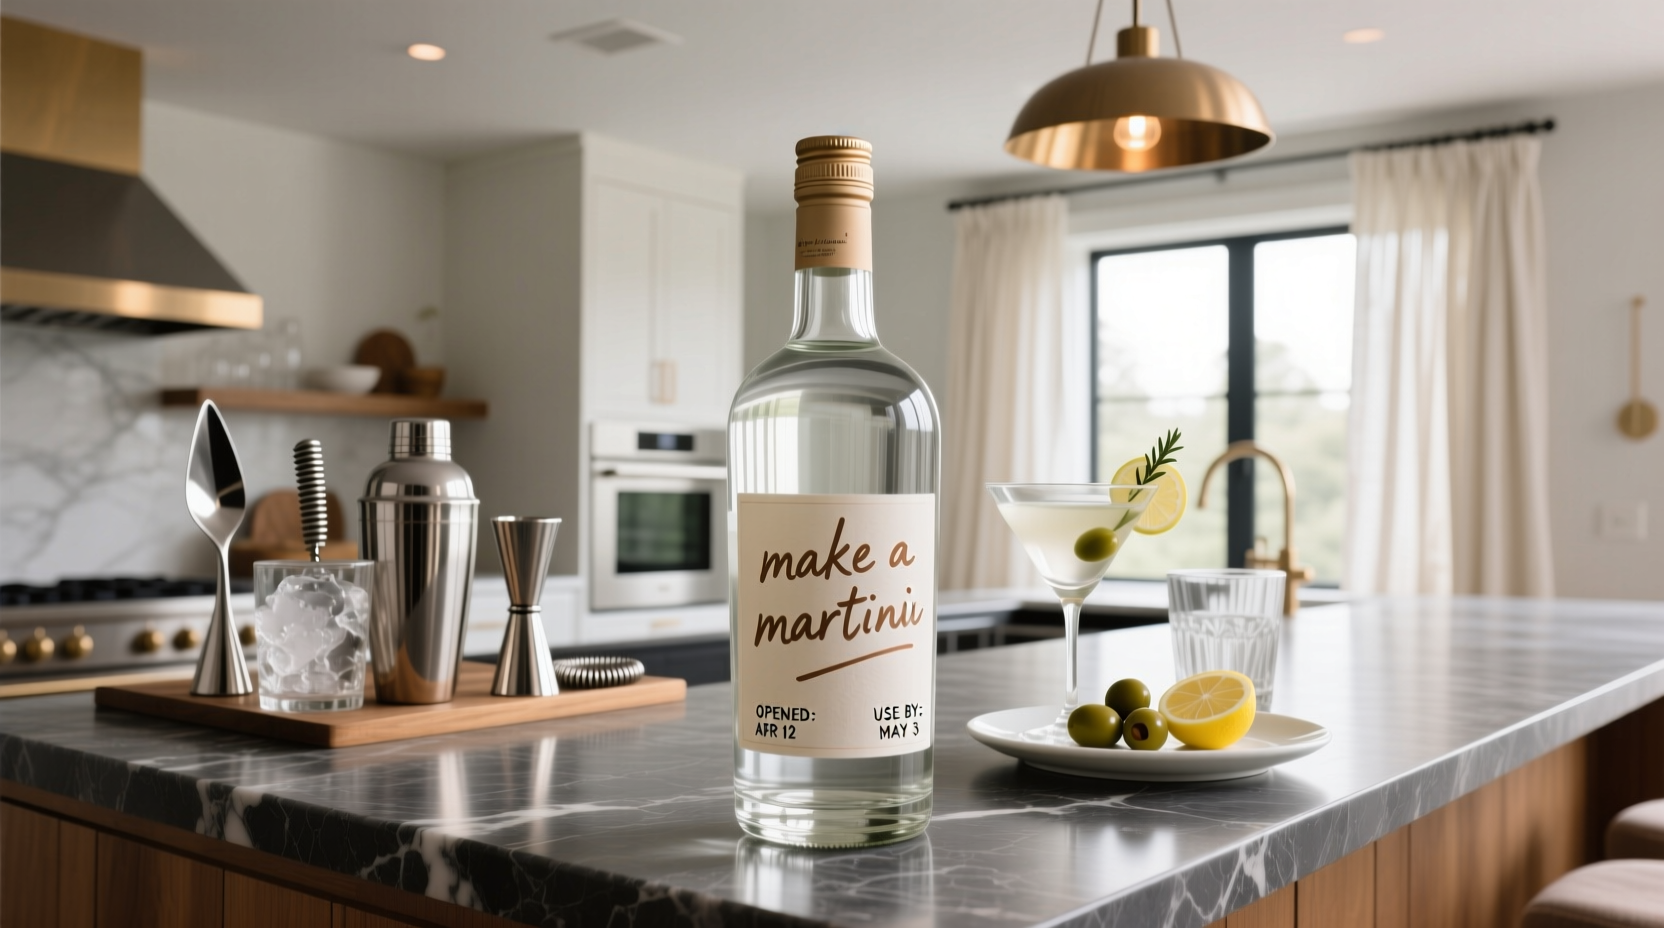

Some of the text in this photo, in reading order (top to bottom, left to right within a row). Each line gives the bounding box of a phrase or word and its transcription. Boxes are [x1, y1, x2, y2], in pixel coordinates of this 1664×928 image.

[760, 517, 915, 583] make a
[756, 704, 816, 721] OPENED:
[873, 703, 923, 721] USE BY:
[783, 725, 796, 740] 12
[879, 722, 919, 740] MAY 3
